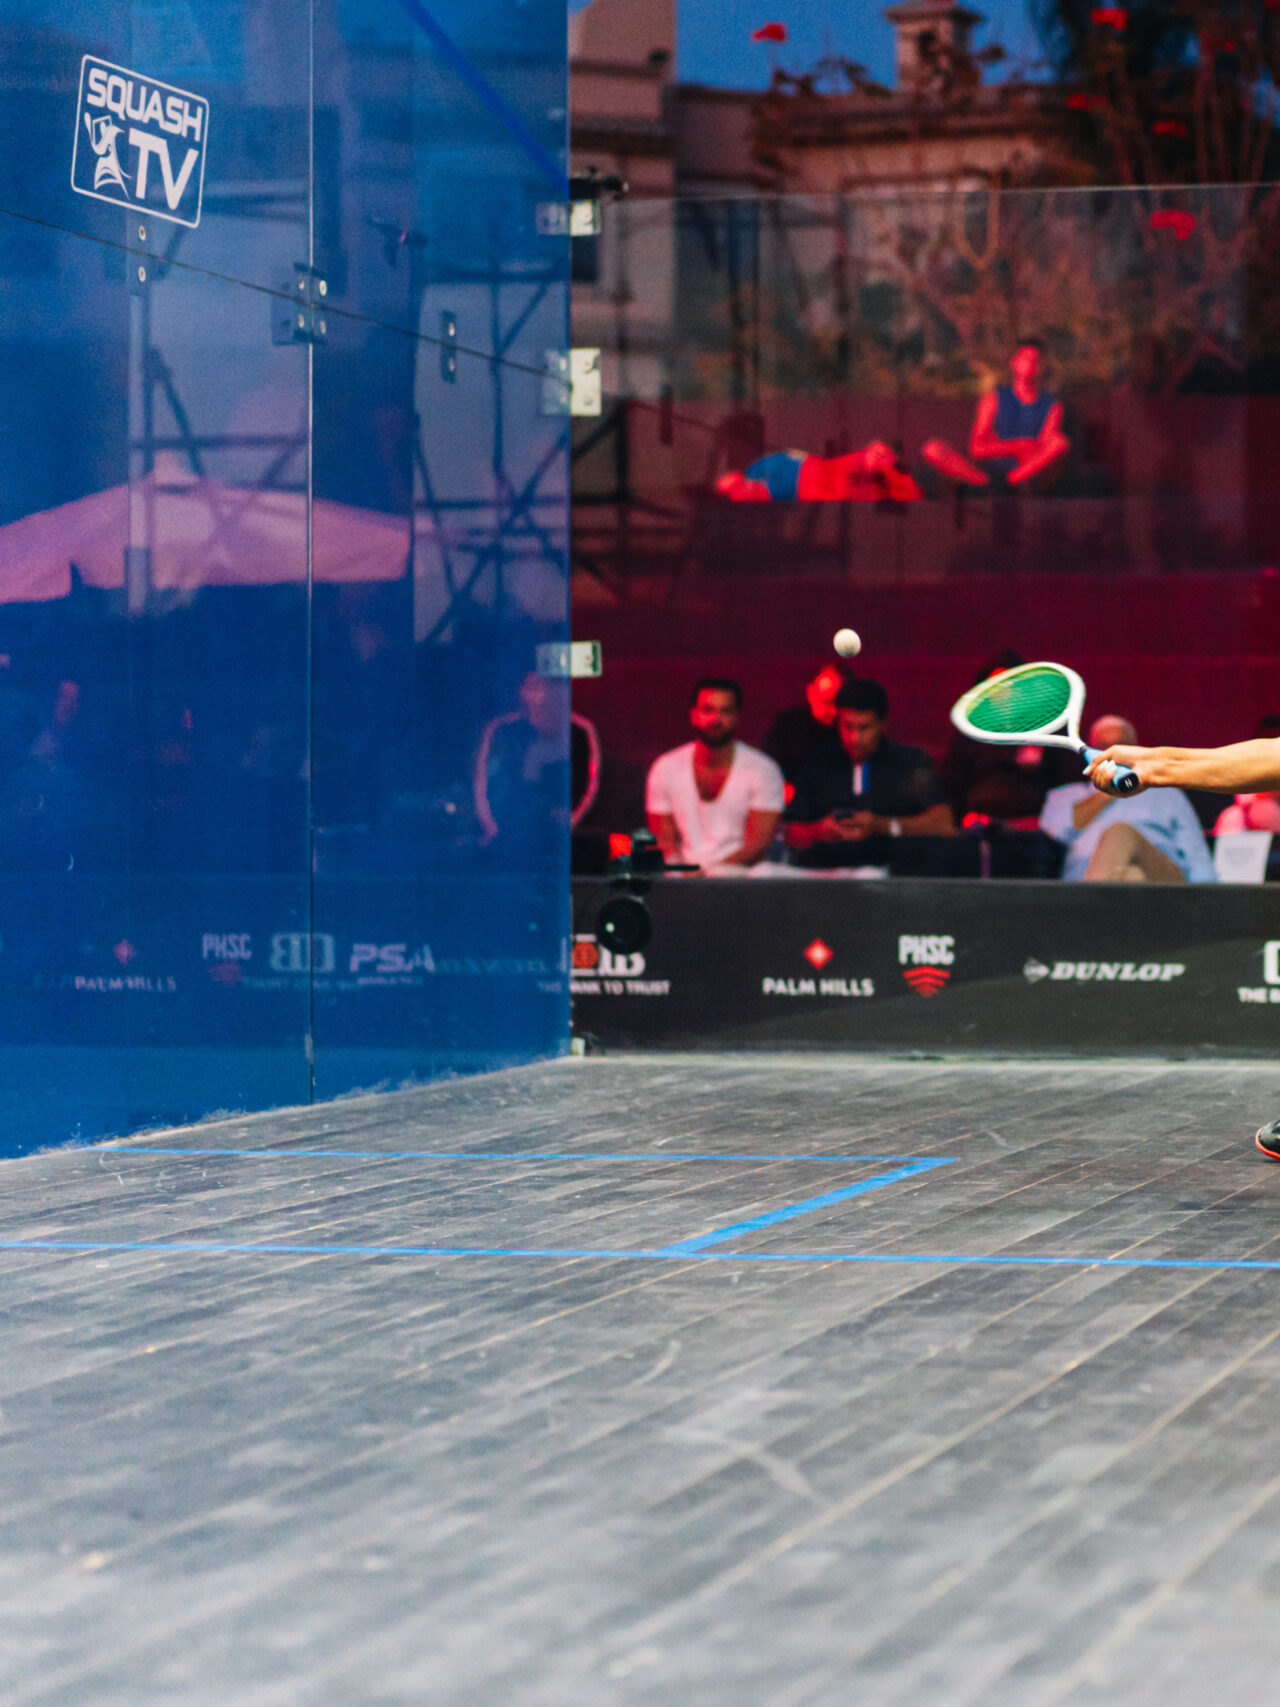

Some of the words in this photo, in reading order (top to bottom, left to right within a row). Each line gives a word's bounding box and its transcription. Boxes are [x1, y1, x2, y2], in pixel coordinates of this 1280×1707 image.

[86, 67, 204, 143] SQUASH
[128, 129, 200, 211] TV
[201, 932, 253, 961] PHSC
[898, 935, 956, 966] PHSC
[1050, 961, 1186, 983] DUNLOP
[626, 979, 672, 996] TRUST
[762, 977, 815, 997] PALM
[820, 978, 875, 998] HILLS
[1237, 987, 1268, 1003] THE
